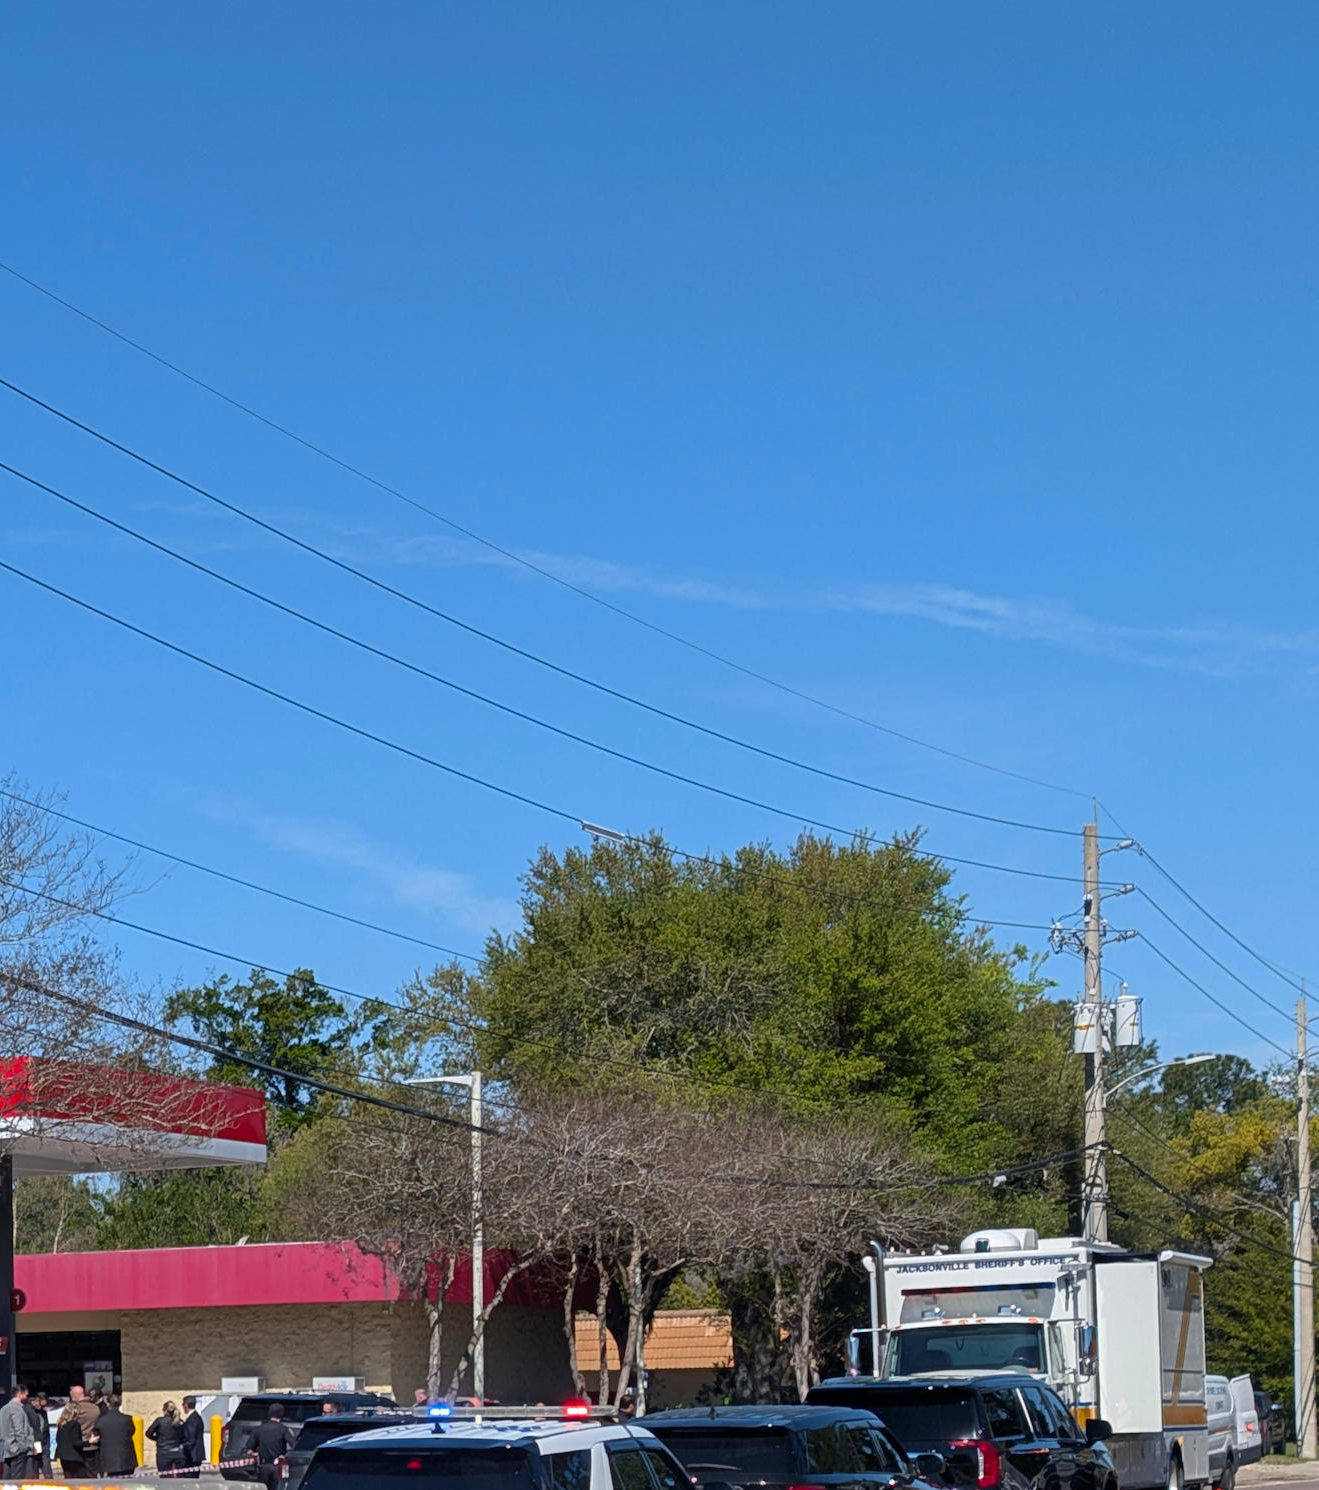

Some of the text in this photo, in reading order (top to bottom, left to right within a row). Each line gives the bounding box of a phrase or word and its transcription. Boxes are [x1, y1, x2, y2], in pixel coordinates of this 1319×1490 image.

[896, 1256, 1065, 1274] JACKSONVILLE SHERIFF'S OFFICE
[14, 1294, 20, 1305] 1
